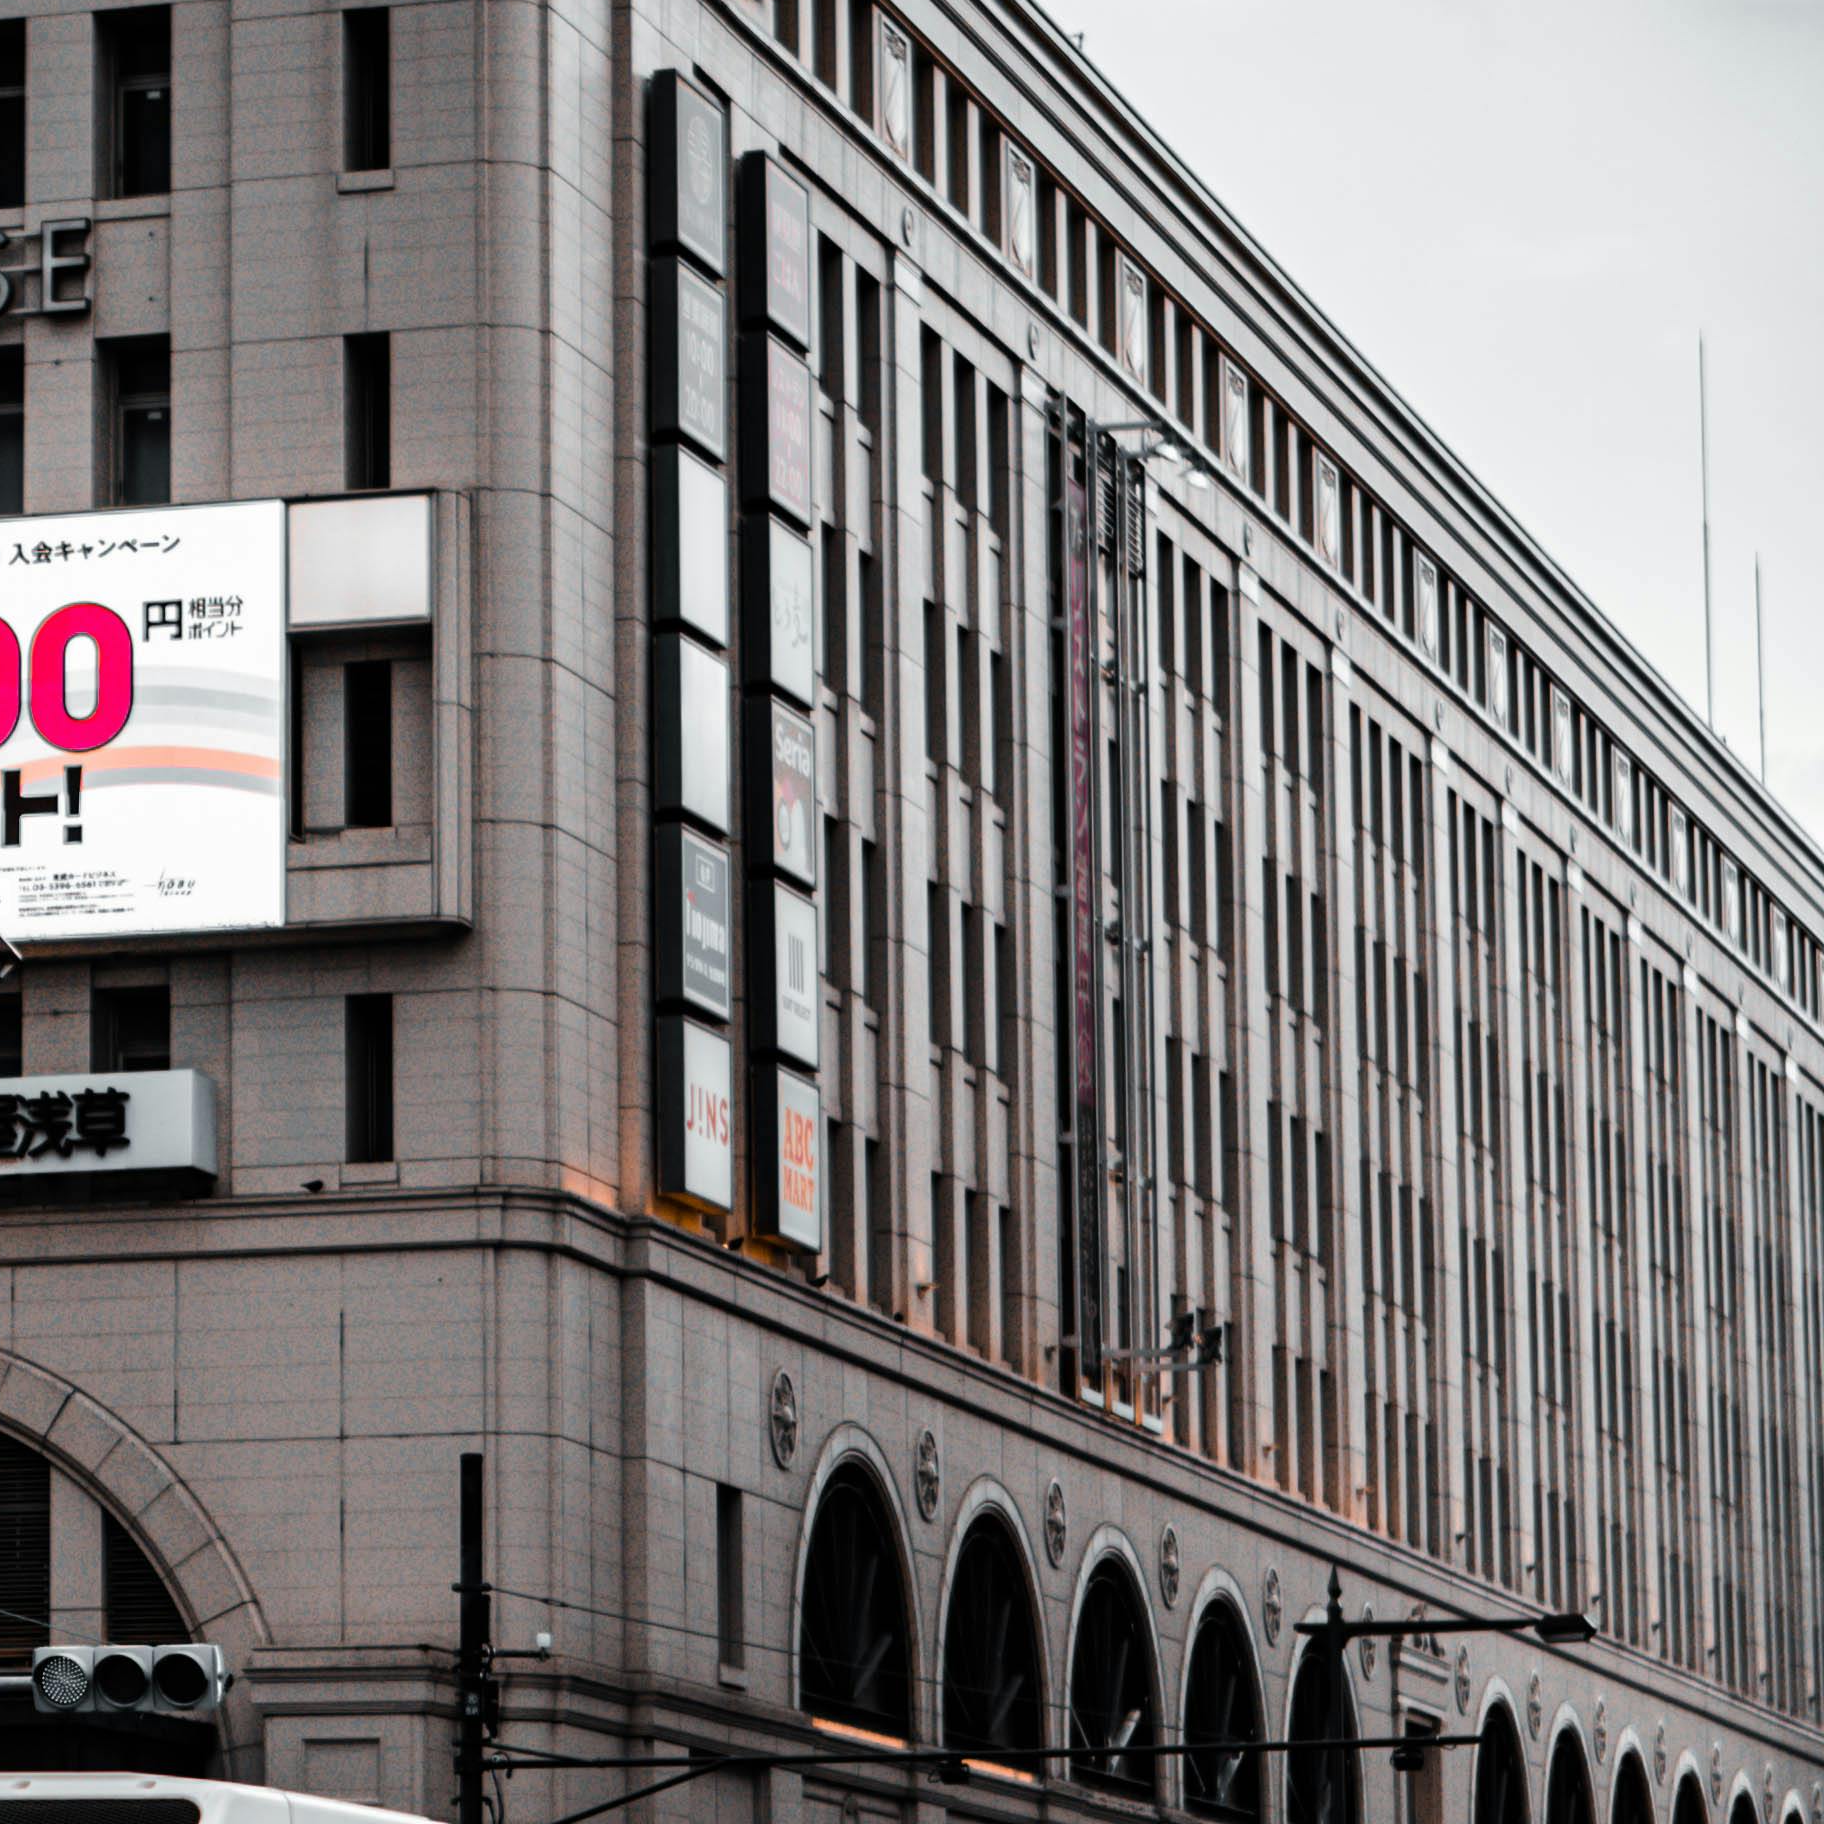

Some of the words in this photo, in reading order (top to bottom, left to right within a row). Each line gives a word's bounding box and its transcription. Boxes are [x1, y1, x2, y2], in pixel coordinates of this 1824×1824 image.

[7, 534, 181, 566] 入会キャンペーン
[141, 599, 183, 642] 円
[188, 596, 244, 619] 相当分
[776, 722, 810, 780] Seria
[782, 1106, 815, 1172] ABC
[783, 1164, 816, 1213] MART
